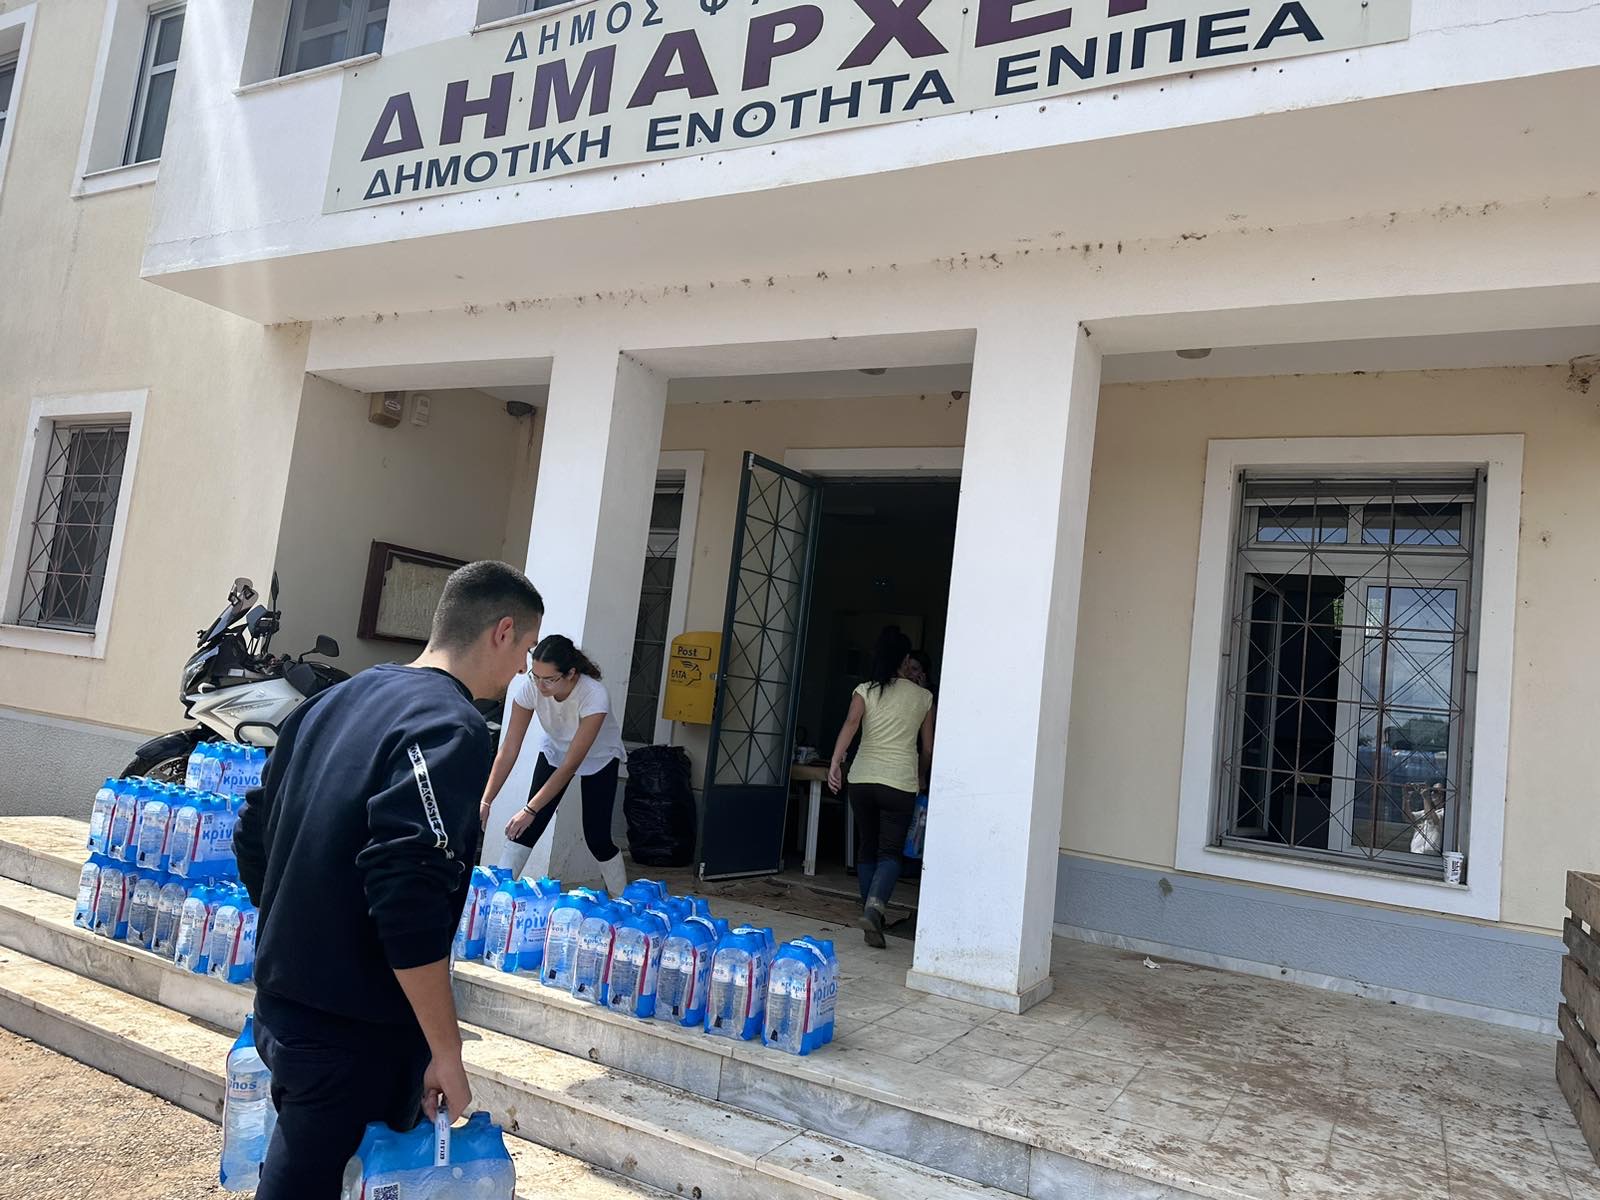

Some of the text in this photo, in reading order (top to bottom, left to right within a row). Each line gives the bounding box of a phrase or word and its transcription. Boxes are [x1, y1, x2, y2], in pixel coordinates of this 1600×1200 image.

[504, 0, 664, 63] ΔΗΜΟΣ
[360, 0, 1148, 162] ΔΗΜΑΡΧΕ
[363, 0, 1325, 201] ΔΗΜΟΤΙΚΗ ΕΝΟΤΗΤΑ ΕΝΙΠΕΑ
[677, 645, 697, 657] Post
[419, 780, 443, 830] LACOSTE
